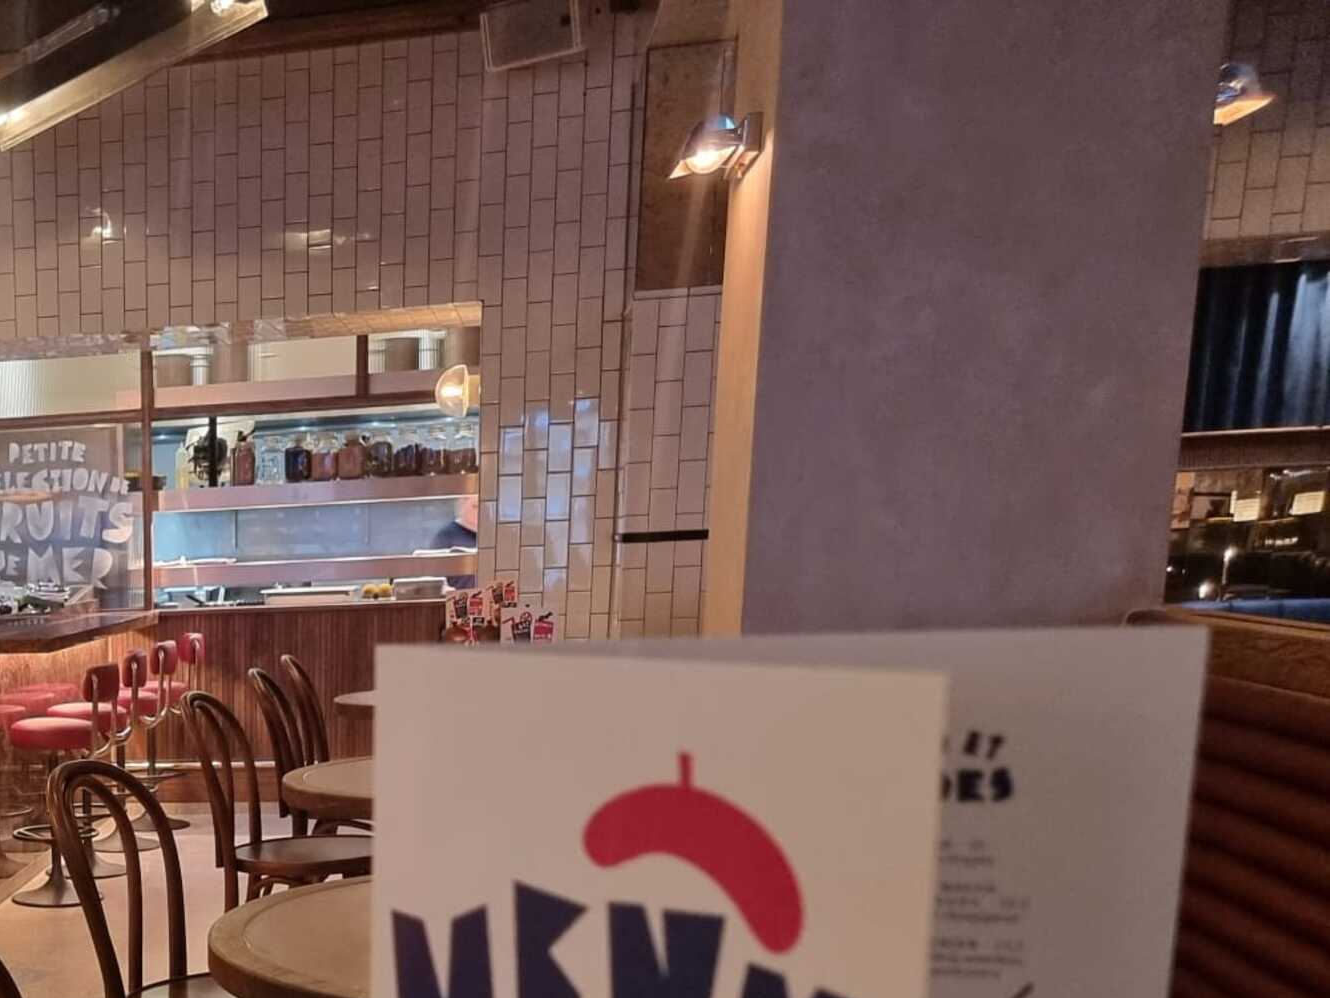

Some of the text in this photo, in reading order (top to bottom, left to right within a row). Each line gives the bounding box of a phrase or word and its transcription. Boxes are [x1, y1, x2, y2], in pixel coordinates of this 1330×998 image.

[8, 440, 87, 465] PETITE
[110, 476, 130, 495] DE
[27, 545, 114, 590] MER
